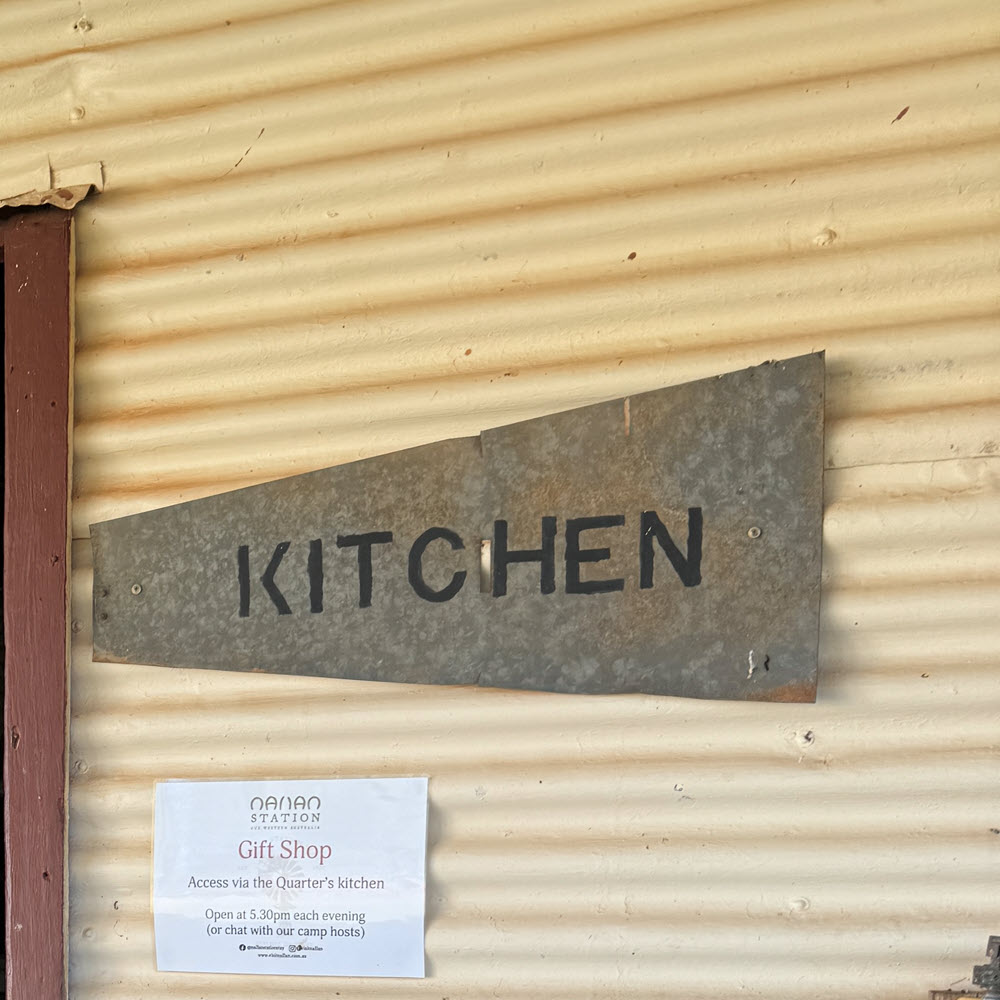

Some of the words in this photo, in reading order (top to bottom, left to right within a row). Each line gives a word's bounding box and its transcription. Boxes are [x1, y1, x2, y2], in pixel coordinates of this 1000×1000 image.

[237, 506, 703, 618] KITCHEN
[250, 813, 321, 823] STATION
[238, 840, 274, 859] Gift
[280, 840, 332, 865] Shop
[187, 876, 229, 889] Access
[232, 876, 249, 889] via
[253, 876, 273, 889] the
[276, 876, 334, 890] Quarter's
[337, 876, 385, 889] kitchen
[205, 908, 234, 924] Open
[236, 910, 247, 920] at
[249, 909, 291, 923] 5.30pm
[293, 909, 319, 921] each
[322, 910, 366, 925] evening
[206, 924, 223, 937] (or
[225, 924, 248, 935] chat
[250, 925, 273, 936] with
[276, 927, 294, 936] our
[297, 927, 327, 940] camp
[330, 925, 366, 939] hosts)
